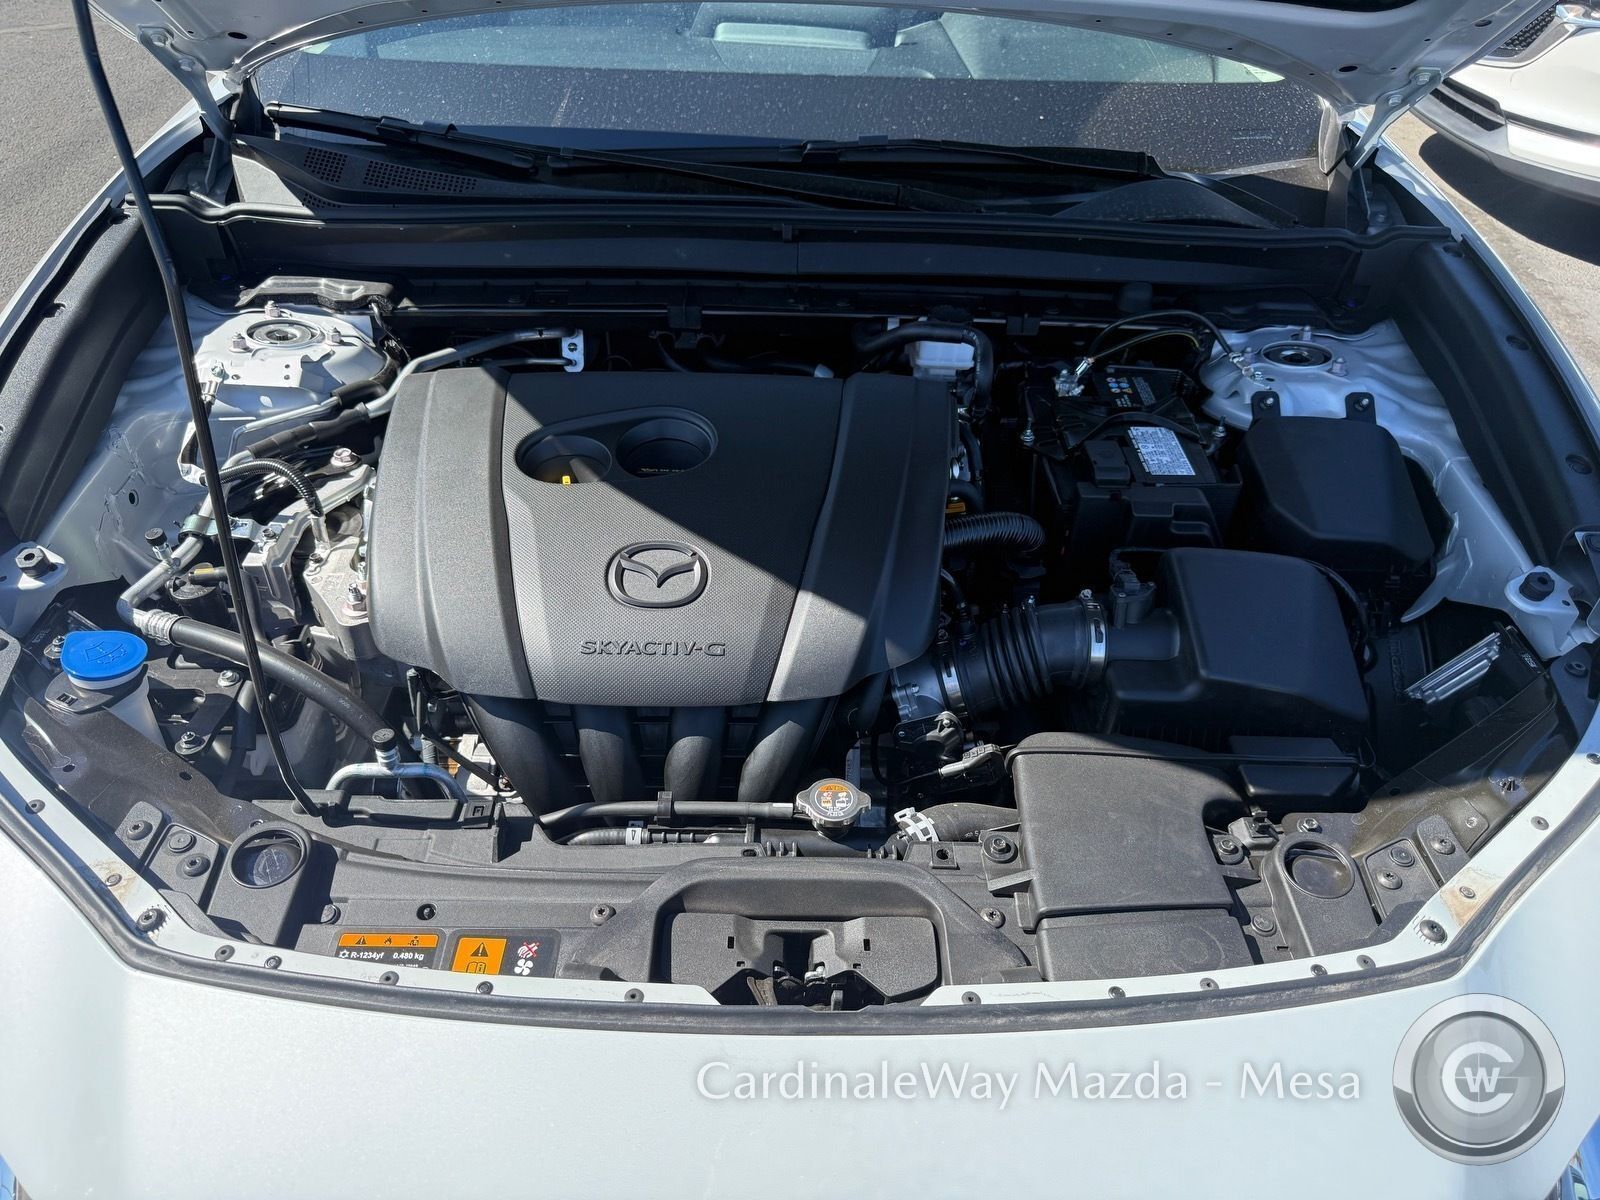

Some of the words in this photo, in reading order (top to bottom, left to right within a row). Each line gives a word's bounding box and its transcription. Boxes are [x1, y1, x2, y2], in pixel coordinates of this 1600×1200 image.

[580, 640, 726, 657] SKYACTIV-G
[351, 952, 384, 961] R-1234yf
[414, 952, 424, 961] kg
